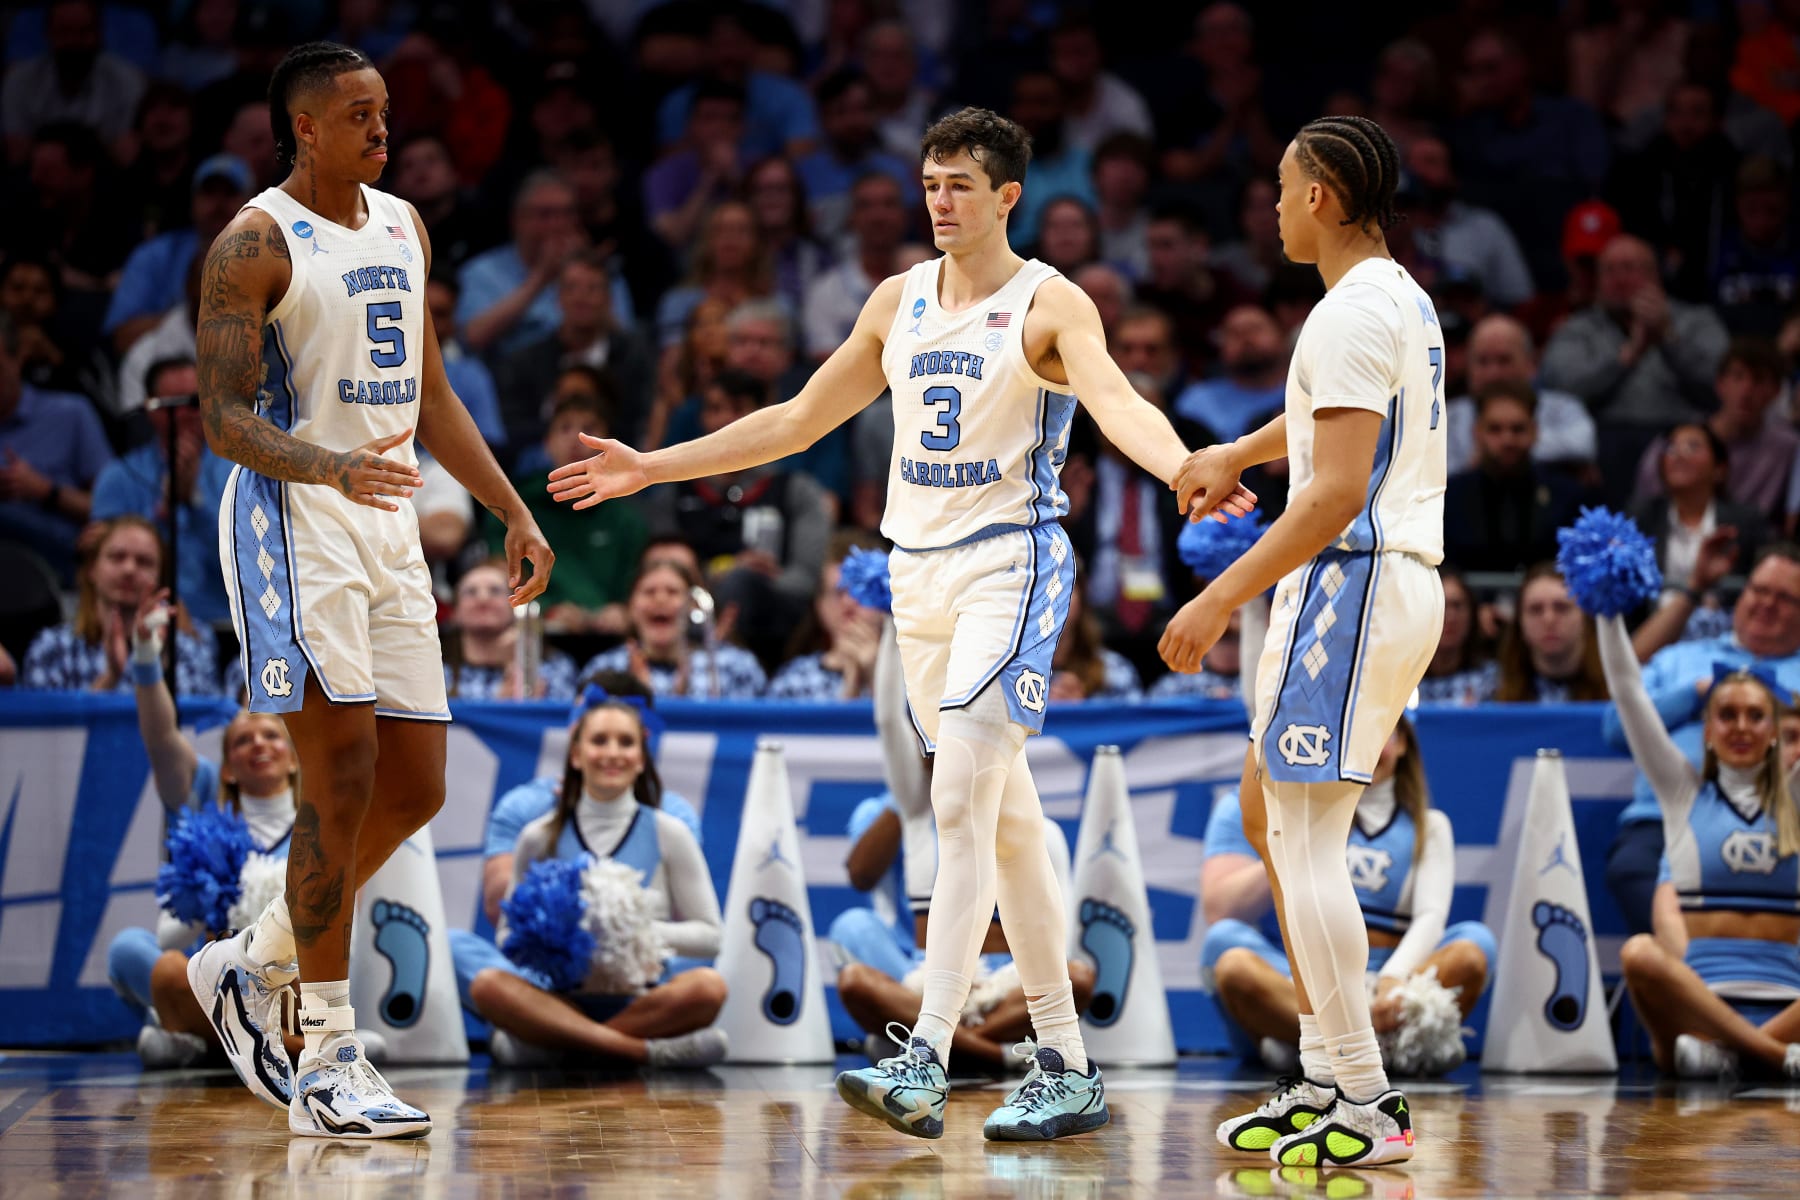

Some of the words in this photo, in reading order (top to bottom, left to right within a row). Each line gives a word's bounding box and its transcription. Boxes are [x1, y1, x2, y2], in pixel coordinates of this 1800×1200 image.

[341, 266, 412, 297] NORTH
[366, 300, 407, 368] 5
[909, 351, 984, 380] NORTH
[920, 386, 961, 451] 3
[900, 456, 1001, 488] CAROLINA
